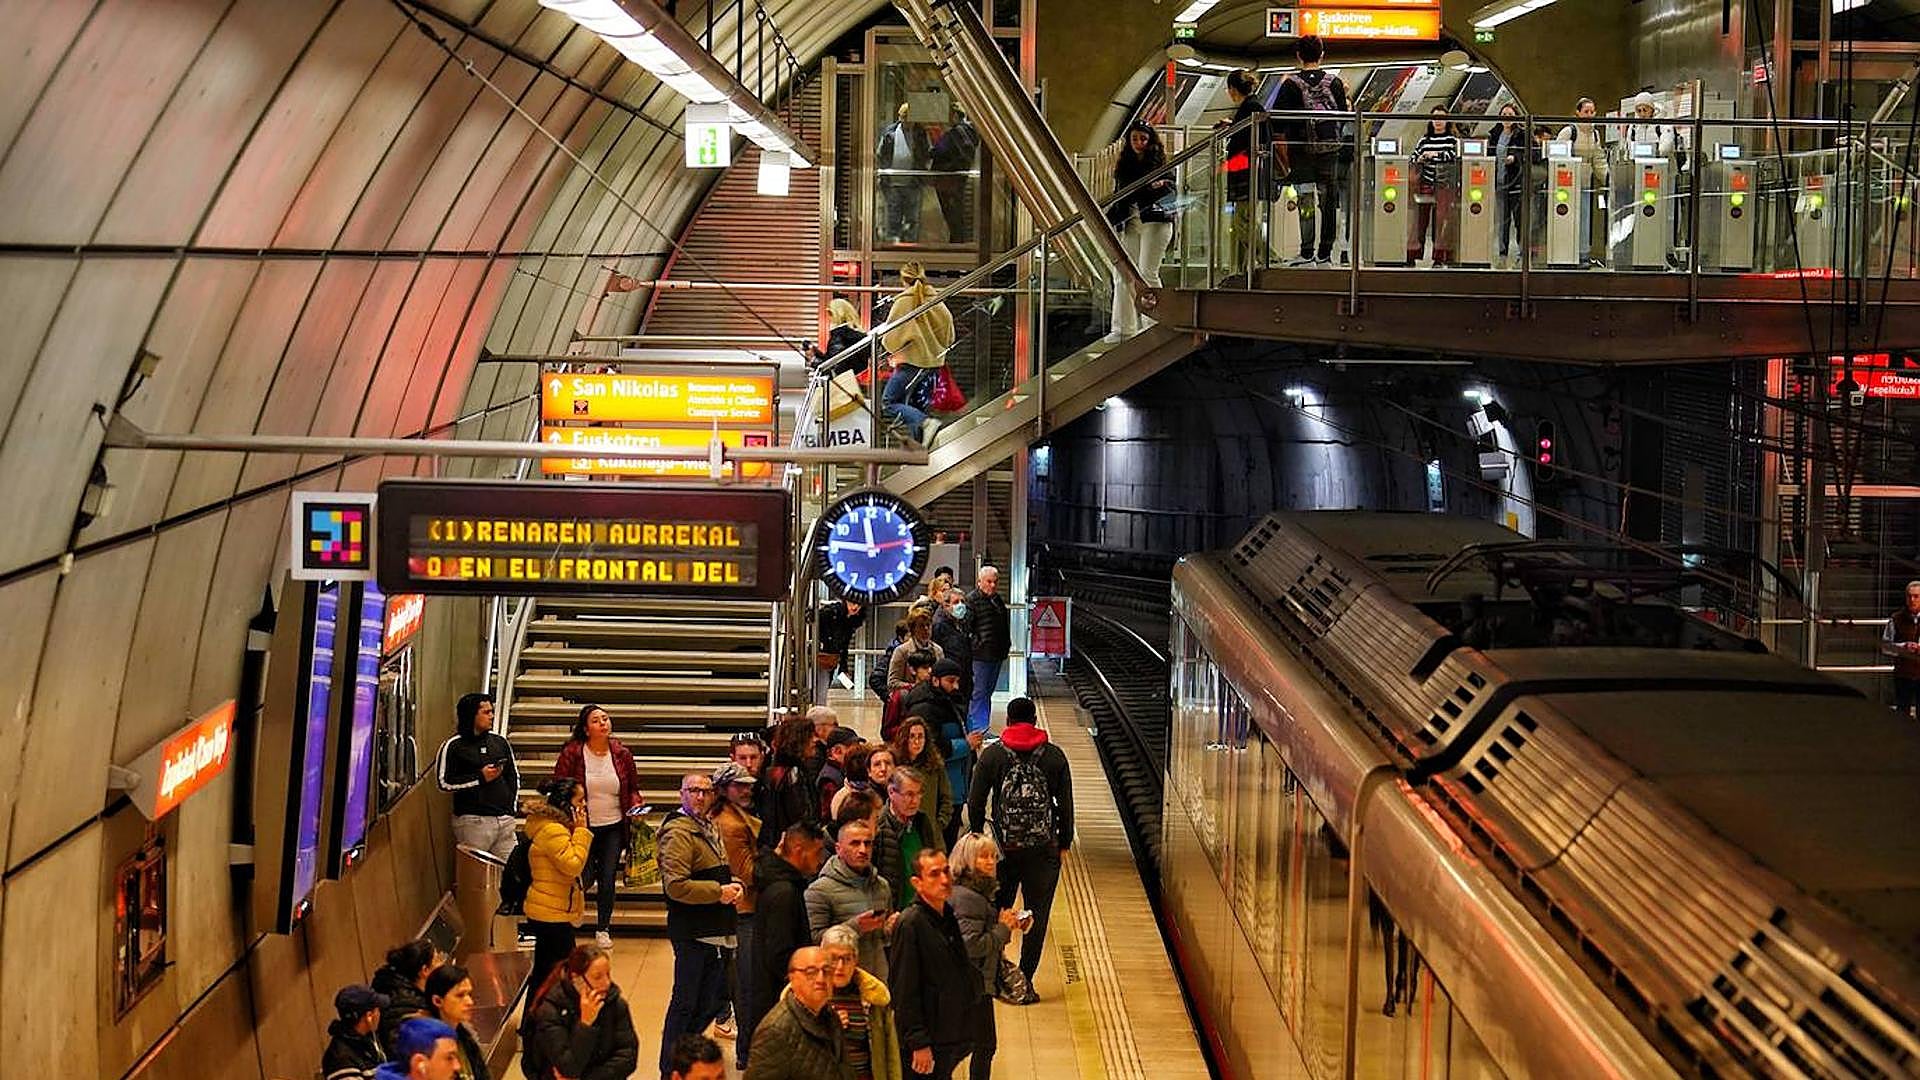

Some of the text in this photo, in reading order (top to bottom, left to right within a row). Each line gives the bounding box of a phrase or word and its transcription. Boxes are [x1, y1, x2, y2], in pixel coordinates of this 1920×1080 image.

[573, 378, 679, 398] San Nikolas
[574, 431, 660, 449] Euskotren
[849, 511, 859, 523] 11
[864, 507, 878, 519] 12
[885, 510, 891, 524] 1
[609, 524, 740, 546] AURREKAL
[836, 523, 850, 536] 10
[897, 523, 907, 536] 2
[459, 557, 491, 578] EN
[510, 557, 541, 579] EL
[559, 558, 673, 581] FRONTAL
[692, 561, 739, 583] DEL
[836, 561, 846, 575] 8
[897, 561, 907, 573] 4
[851, 572, 859, 586] 7
[866, 577, 876, 590] 6
[885, 572, 894, 585] 5
